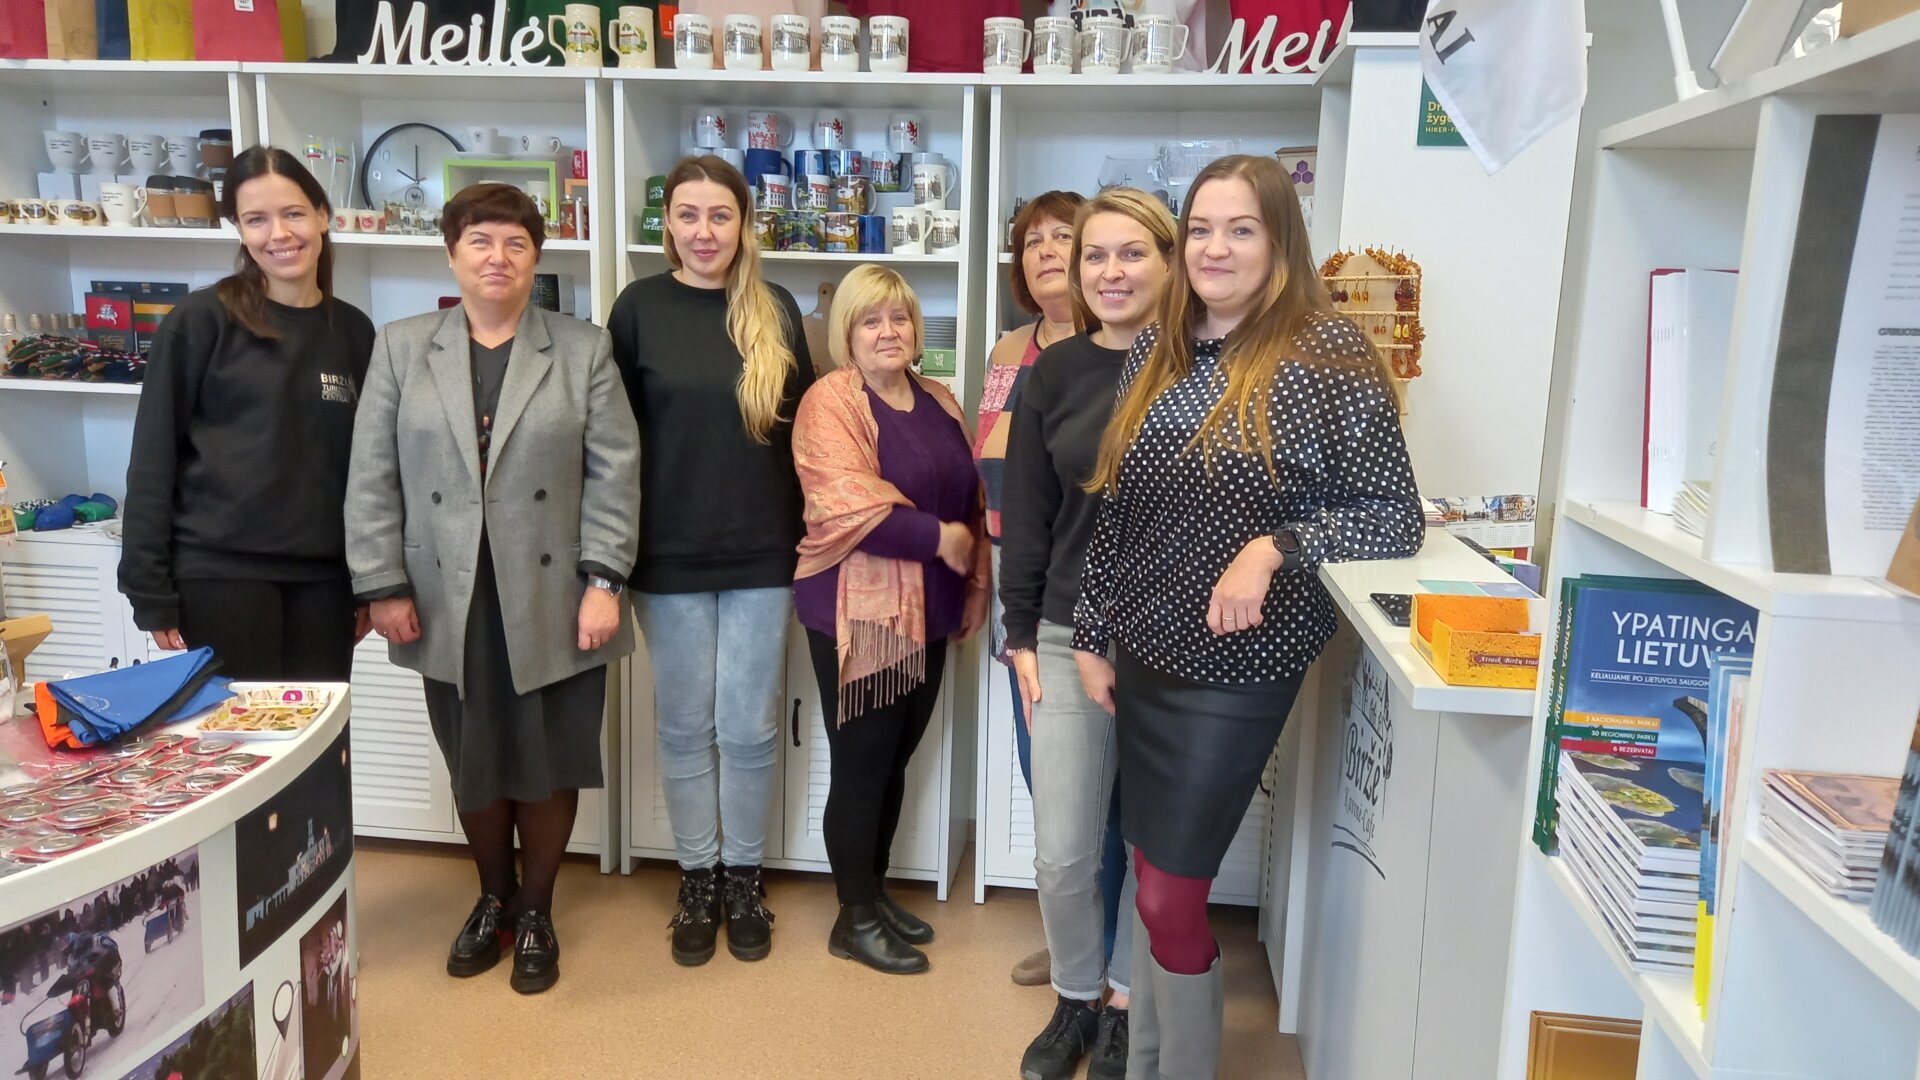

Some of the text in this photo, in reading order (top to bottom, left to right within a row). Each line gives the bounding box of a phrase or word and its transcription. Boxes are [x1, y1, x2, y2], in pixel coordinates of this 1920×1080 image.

[357, 0, 551, 66] Meilė
[1612, 611, 1755, 644] YPATINGA
[1616, 639, 1737, 669] LIETUV
[1590, 671, 1631, 682] KELIAUJAME
[1644, 677, 1677, 685] LIETUVOS
